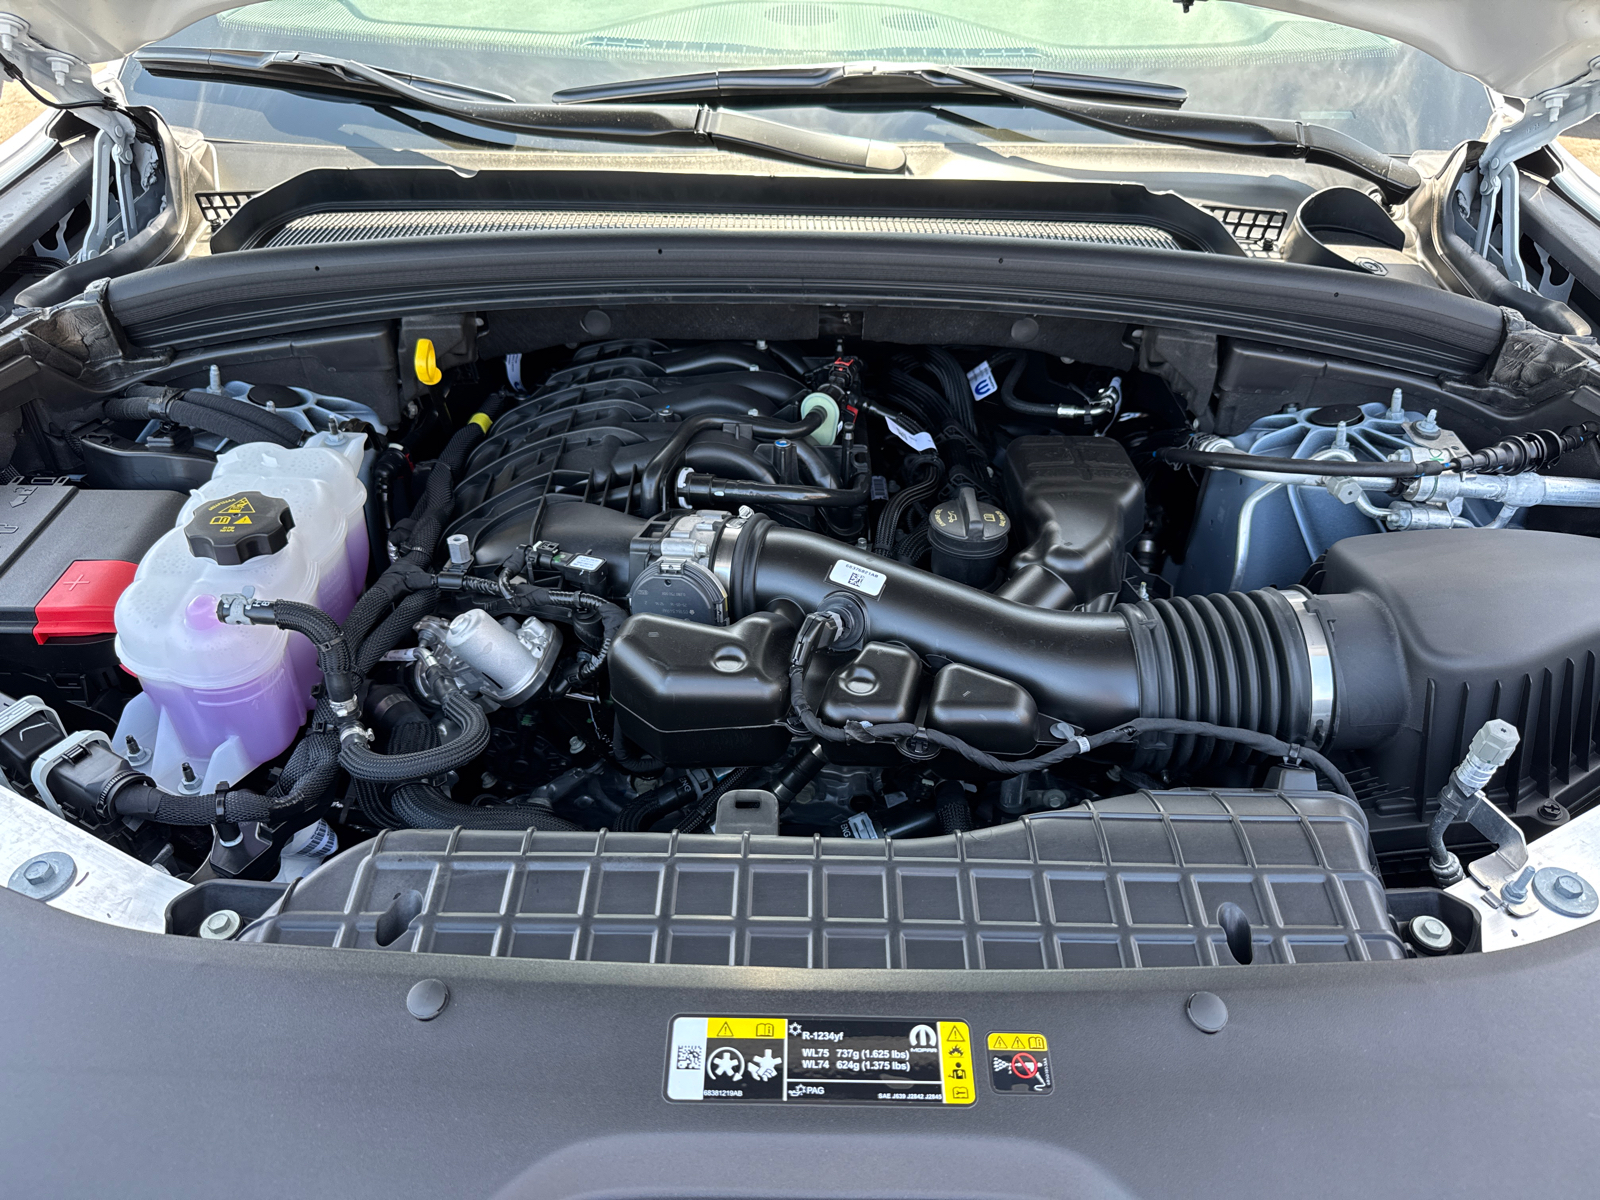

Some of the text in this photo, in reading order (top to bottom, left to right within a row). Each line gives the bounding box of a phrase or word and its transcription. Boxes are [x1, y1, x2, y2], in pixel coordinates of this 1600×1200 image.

[802, 1031, 844, 1042] R-1234yf
[802, 1048, 910, 1060] WL75 737g (1.625 lbs)
[802, 1060, 911, 1072] WL74 624g (1.375 lbs)
[806, 1086, 825, 1095] PAG
